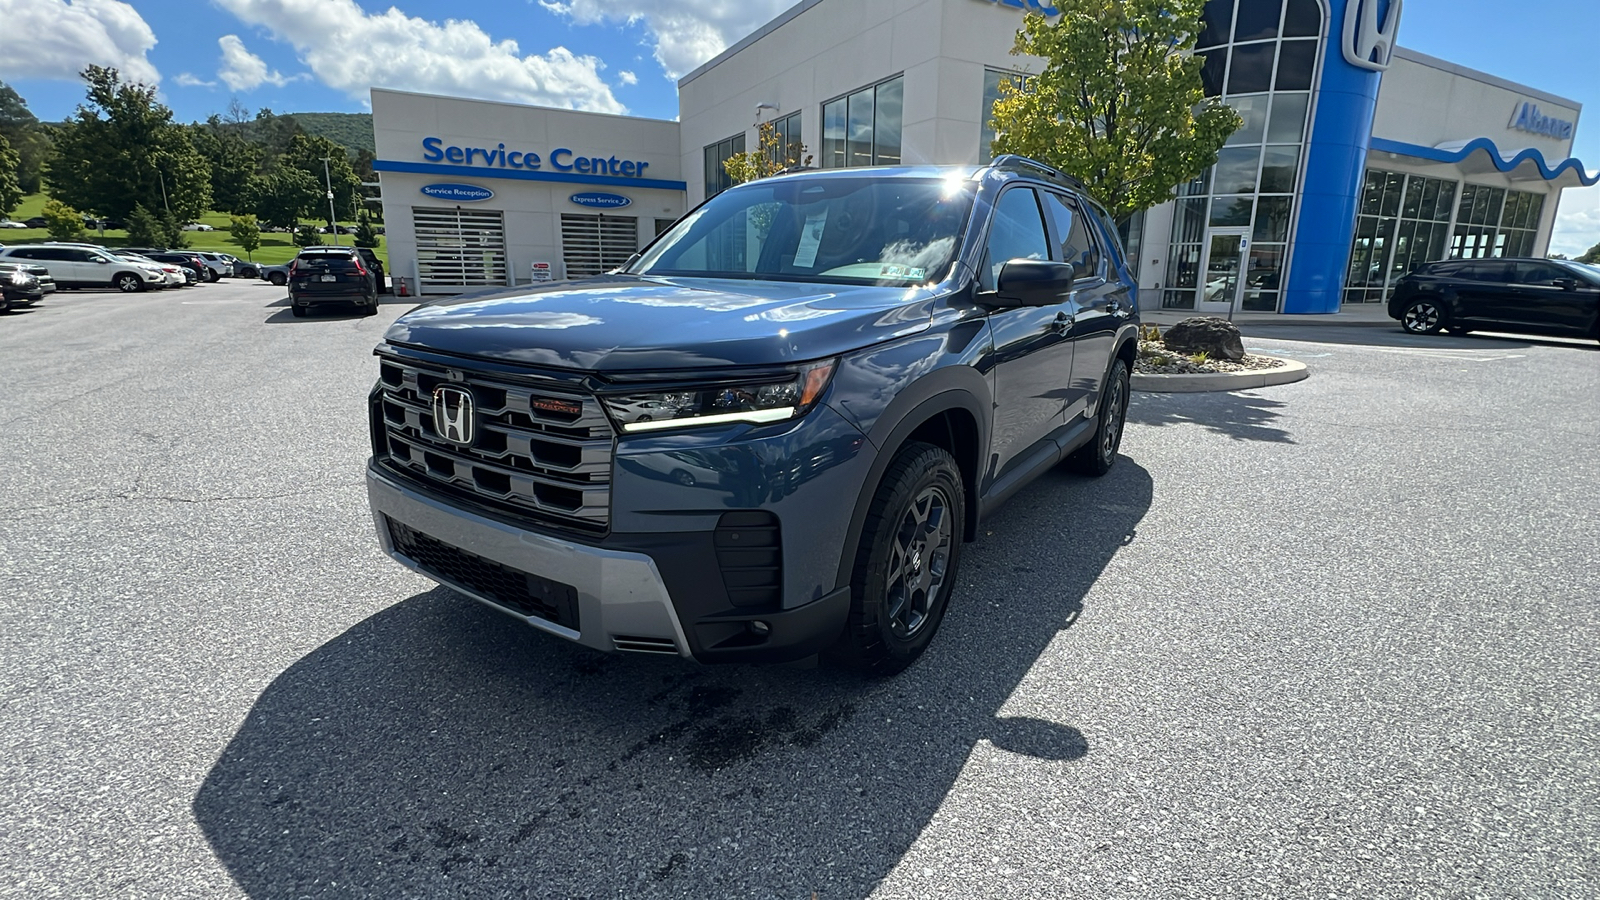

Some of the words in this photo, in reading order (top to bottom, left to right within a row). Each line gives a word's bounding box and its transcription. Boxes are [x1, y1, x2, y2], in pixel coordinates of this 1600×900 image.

[422, 136, 541, 169] Service
[550, 147, 649, 178] Center
[424, 187, 453, 195] Service
[453, 188, 490, 197] Reception
[572, 195, 597, 204] Express
[596, 196, 620, 204] Service
